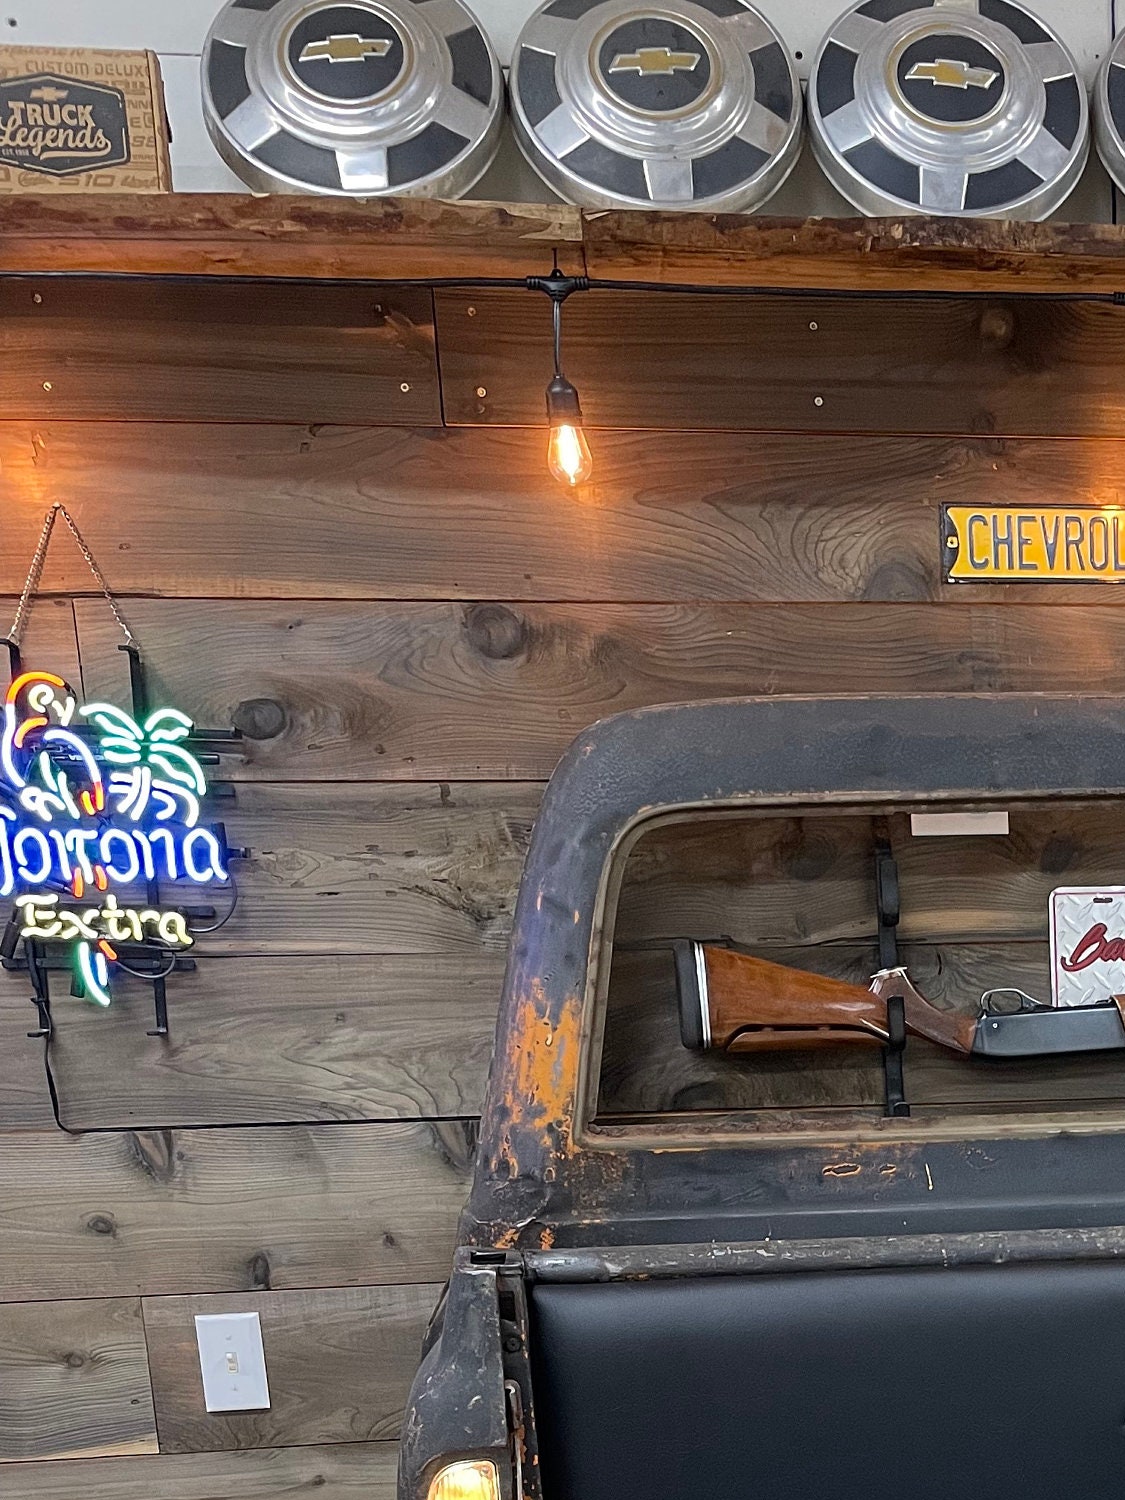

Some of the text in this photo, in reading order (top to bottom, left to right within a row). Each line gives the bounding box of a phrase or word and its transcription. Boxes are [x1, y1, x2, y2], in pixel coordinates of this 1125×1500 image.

[7, 100, 96, 127] TRUCK
[0, 116, 112, 160] Legends
[16, 894, 195, 945] Extra
